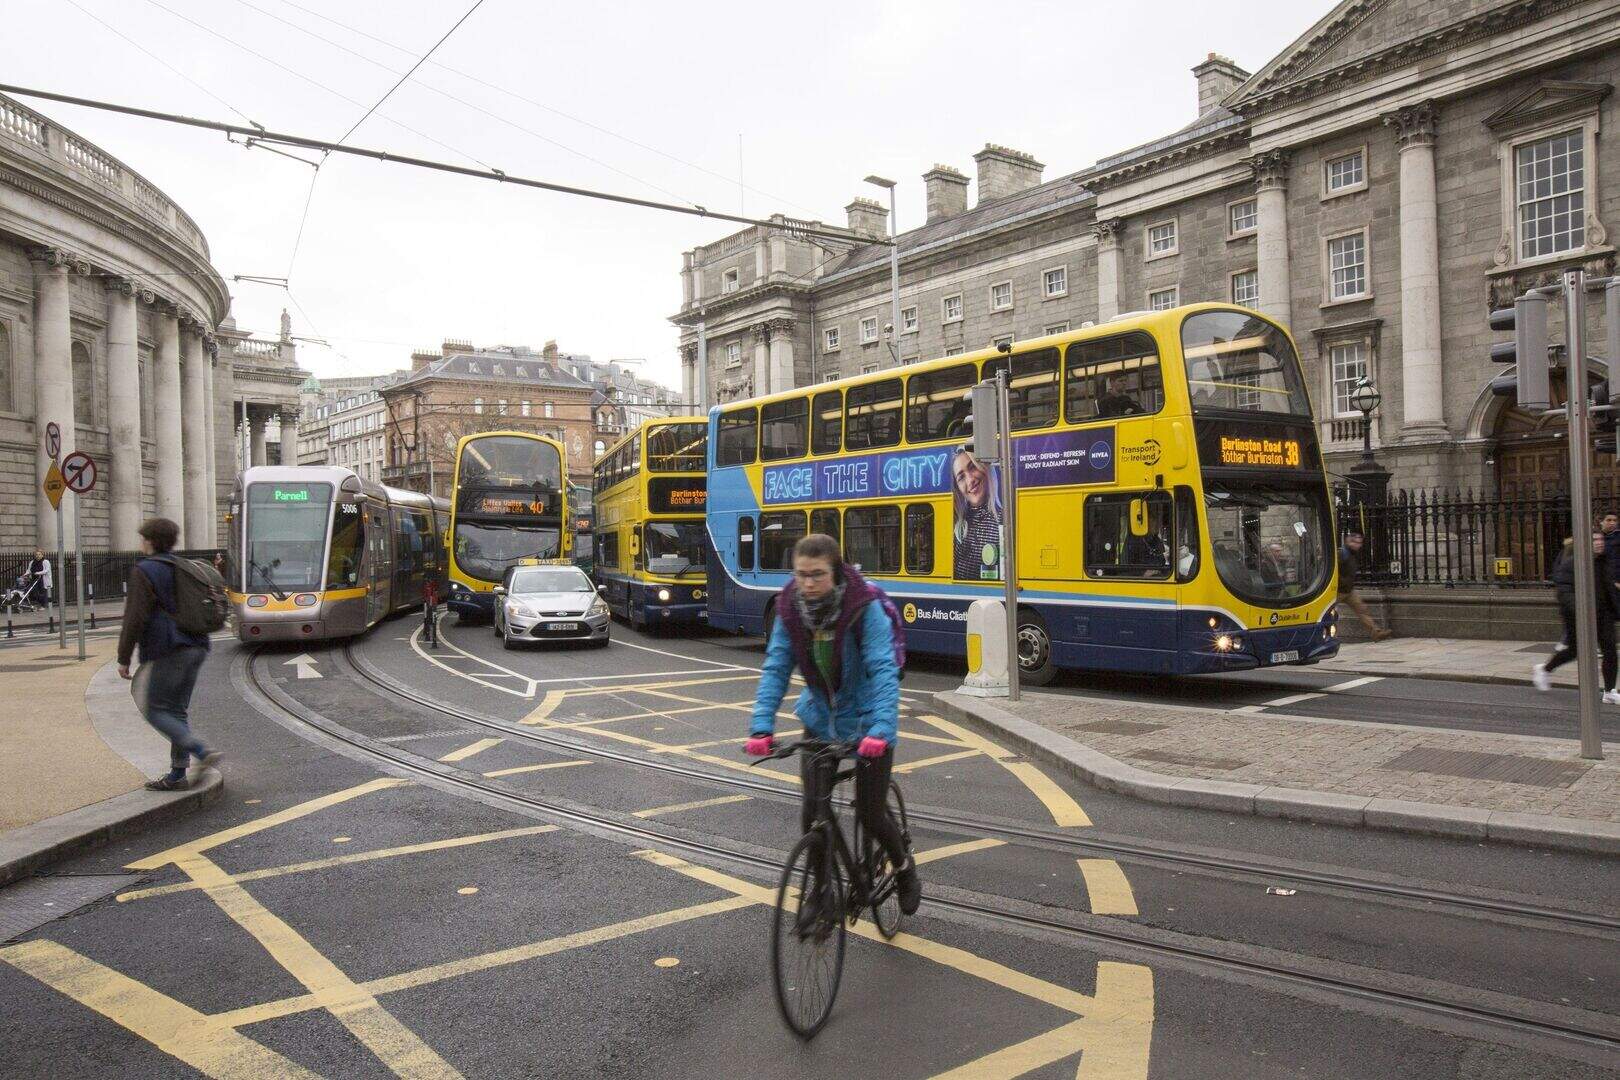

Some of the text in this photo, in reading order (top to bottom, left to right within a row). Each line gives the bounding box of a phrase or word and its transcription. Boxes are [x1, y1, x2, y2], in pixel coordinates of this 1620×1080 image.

[1121, 445, 1156, 454] Transport
[1221, 437, 1282, 453] Burlington Road
[1019, 449, 1086, 462] DETOX DEFEND REFRESH
[1091, 451, 1109, 459] NIVEA
[1130, 453, 1156, 462] Ireland
[1285, 441, 1299, 465] 38
[1024, 458, 1080, 470] ENJOY RADIANT SKIN
[765, 453, 948, 499] FACE THE CITY
[275, 490, 308, 500] Parnell
[342, 503, 358, 513] 5006
[529, 501, 544, 514] 40
[1497, 561, 1509, 574] H
[917, 608, 931, 619] Bus
[931, 606, 949, 620] Átha
